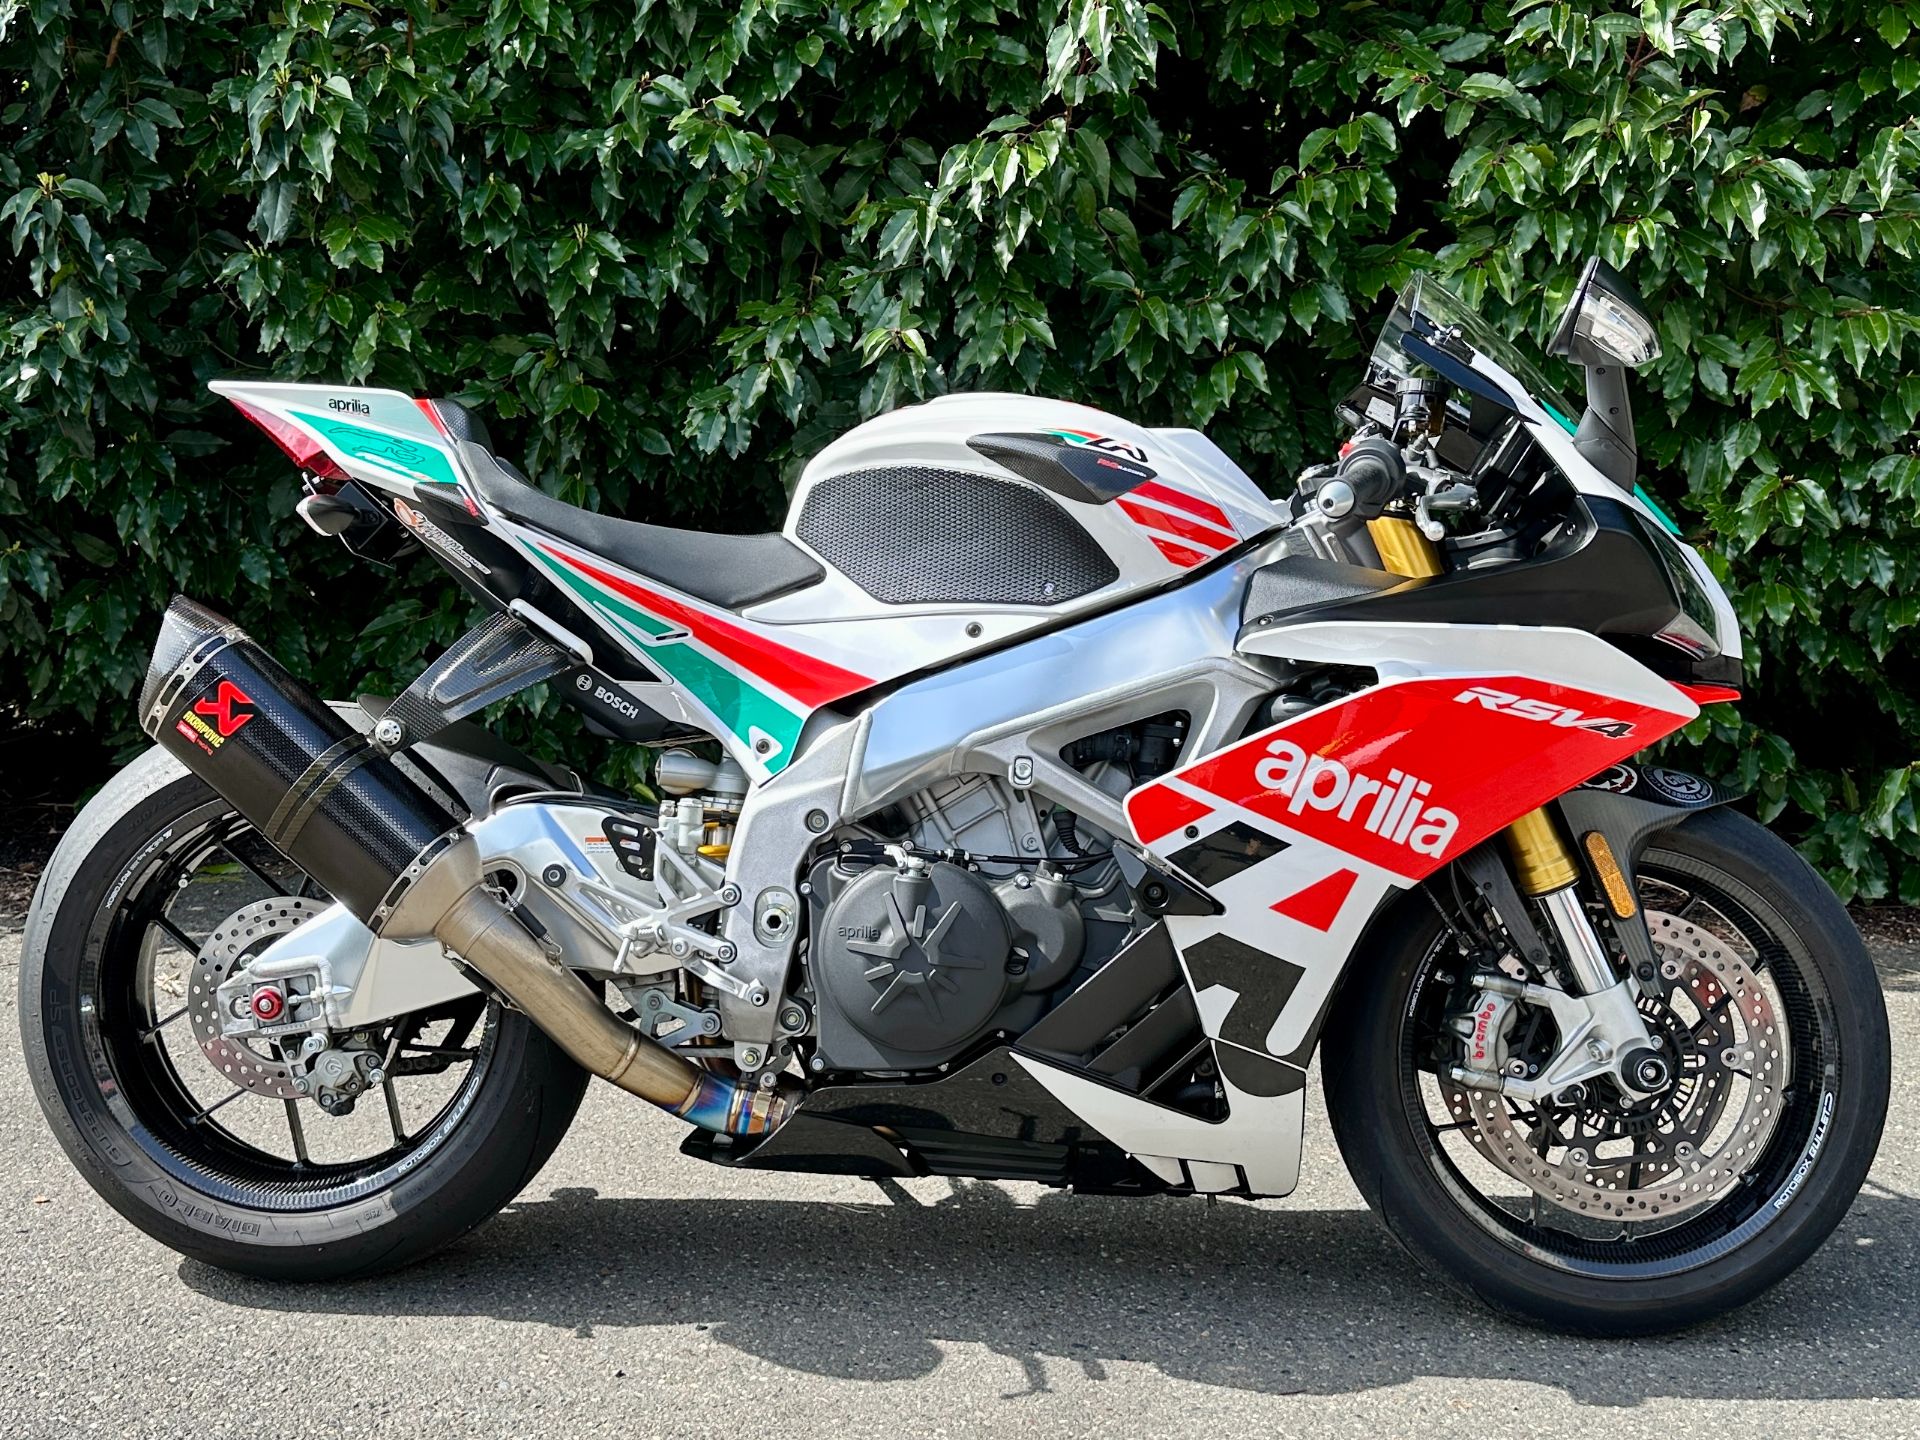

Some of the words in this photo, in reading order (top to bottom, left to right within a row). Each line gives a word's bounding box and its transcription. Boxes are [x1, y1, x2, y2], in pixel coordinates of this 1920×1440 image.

[328, 398, 370, 414] aprilia
[594, 685, 639, 719] BOSCH
[1453, 686, 1637, 740] RSV4
[1254, 738, 1460, 860] aprilia
[838, 924, 881, 941] aprilia
[1472, 1002, 1496, 1060] brembo
[397, 1134, 443, 1174] ROTOBOX
[443, 1090, 476, 1135] BULLET
[1773, 1158, 1812, 1210] ROTOBOX
[1808, 1107, 1831, 1160] BULLET
[158, 1189, 261, 1237] DIABLO
